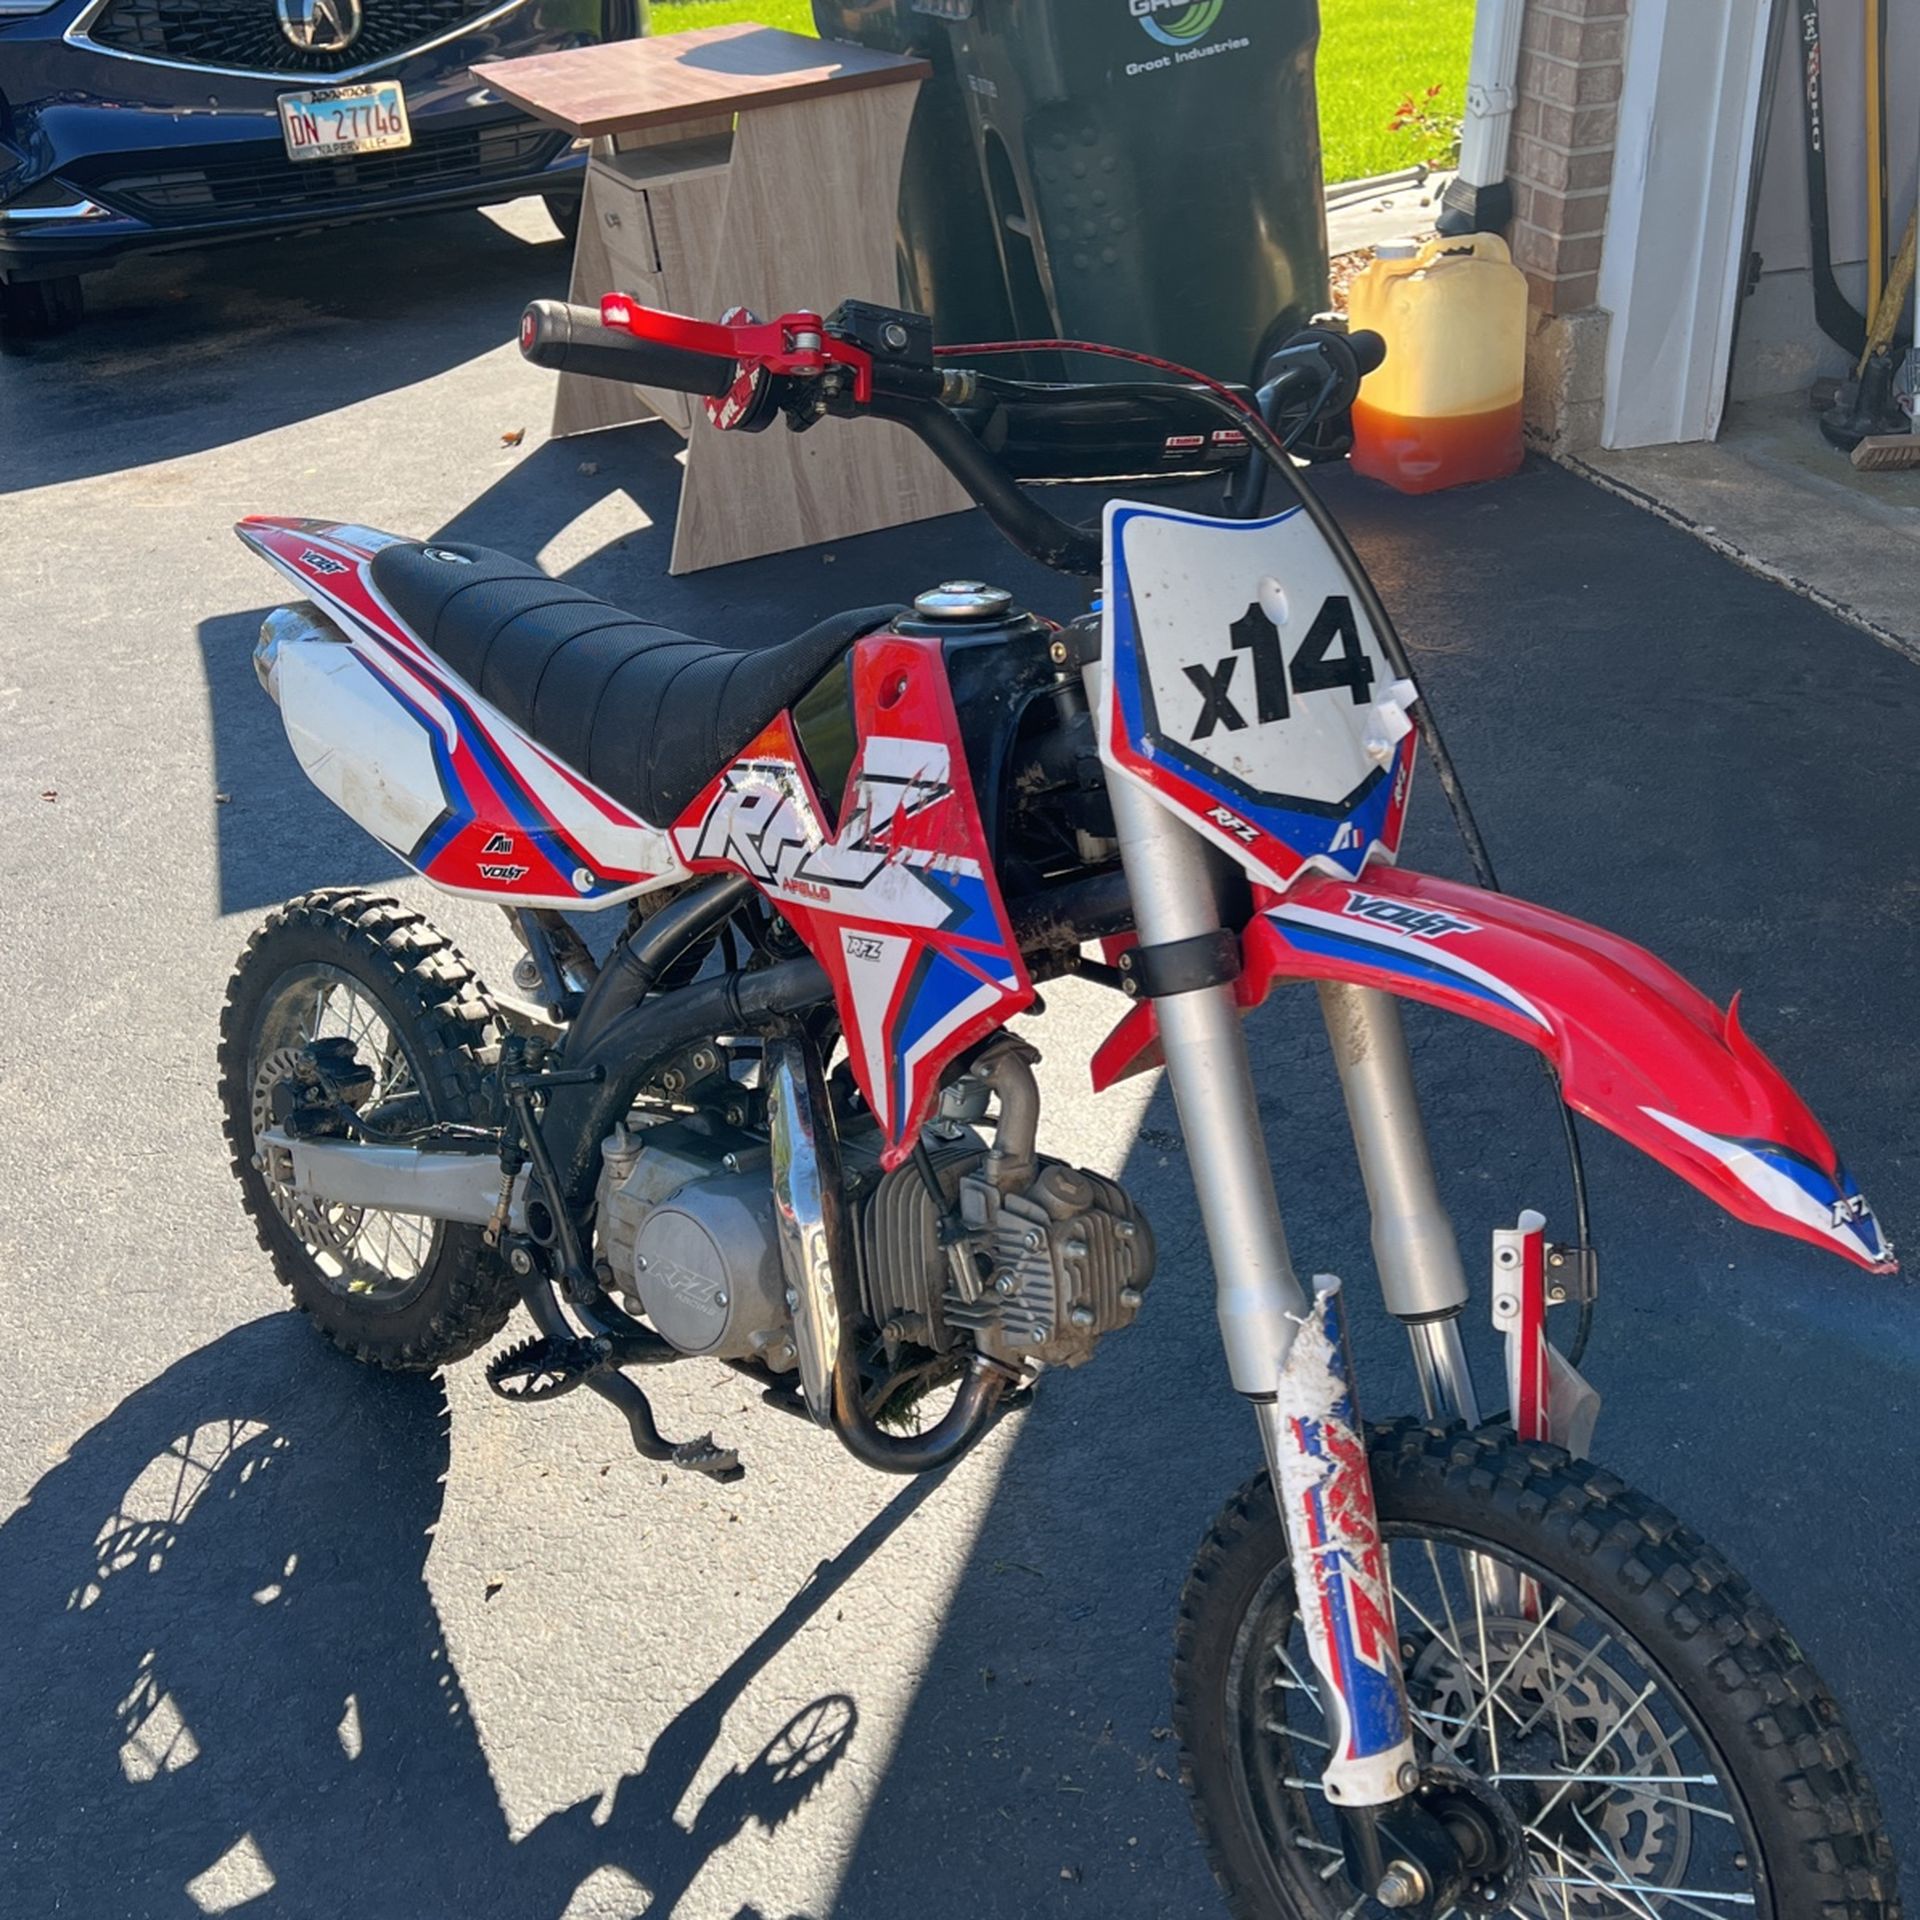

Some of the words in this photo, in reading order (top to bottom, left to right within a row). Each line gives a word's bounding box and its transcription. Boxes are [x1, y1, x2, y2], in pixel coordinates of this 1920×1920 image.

[1126, 56, 1171, 75] Groot
[1175, 38, 1250, 63] Industries
[290, 111, 319, 146] DN
[332, 102, 401, 140] 27746
[1206, 806, 1261, 844] RFZ
